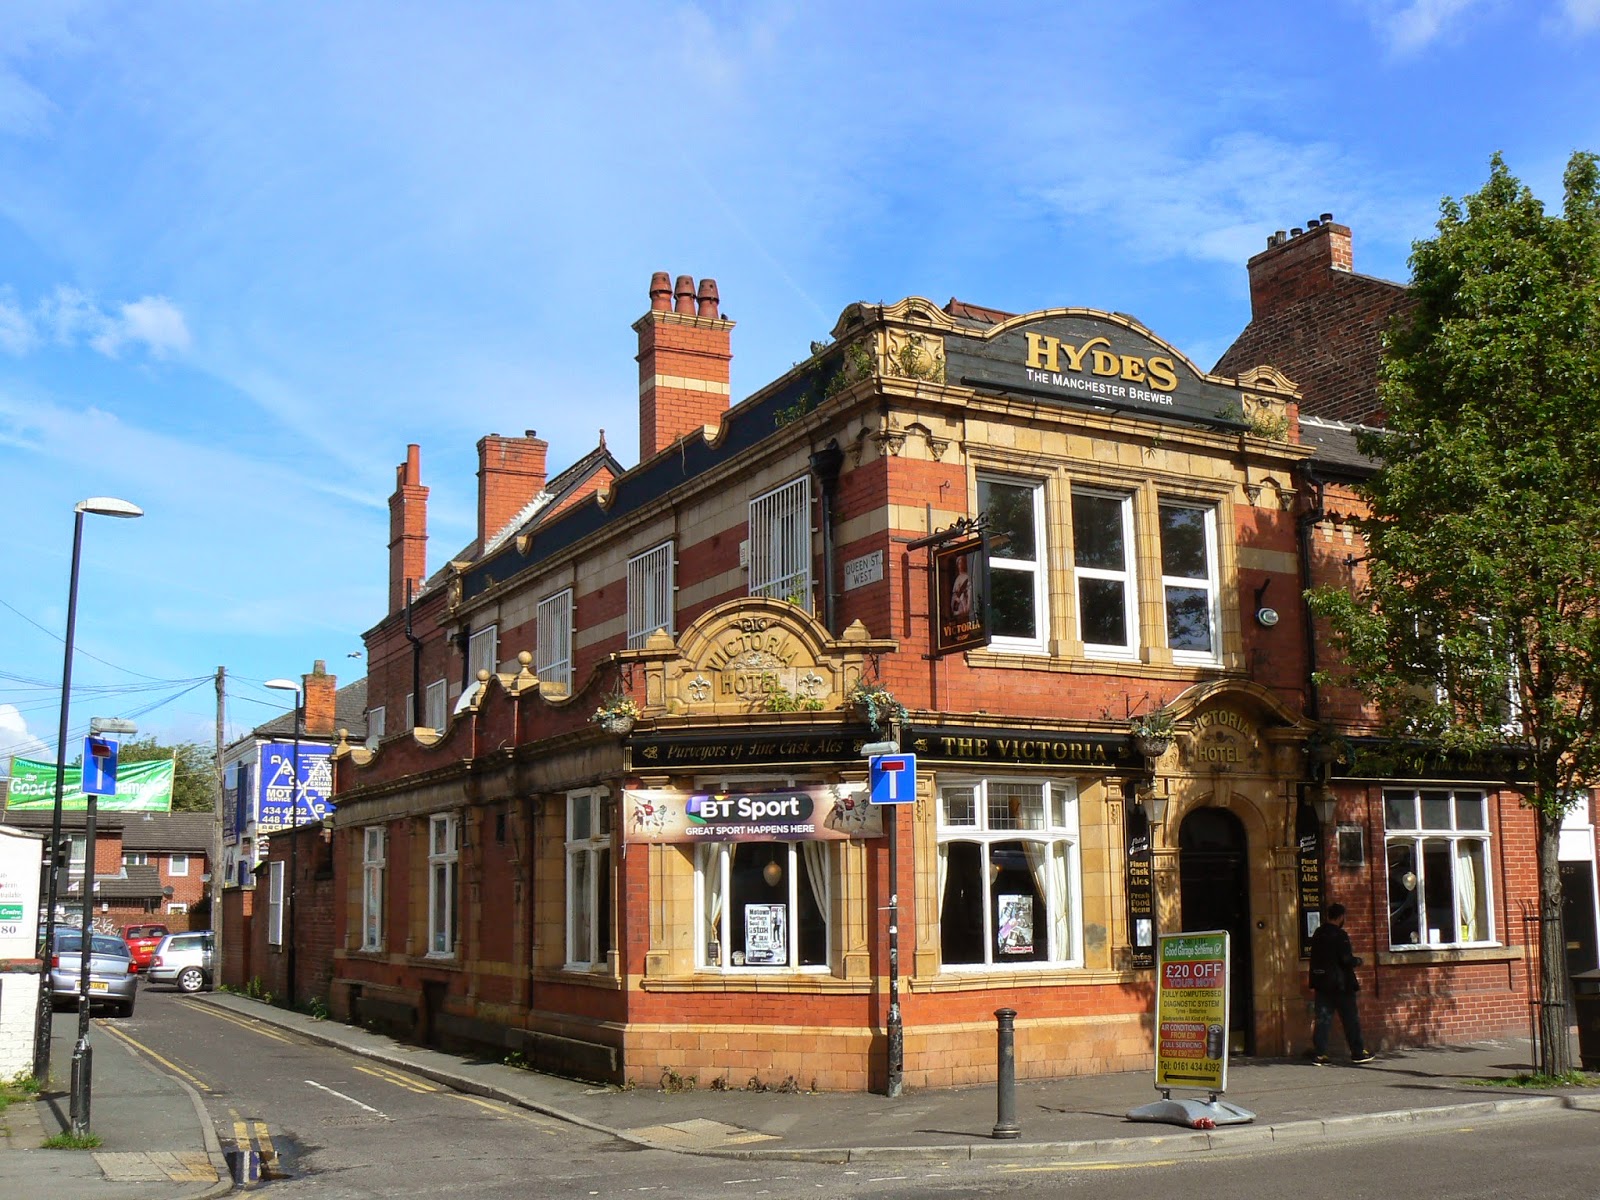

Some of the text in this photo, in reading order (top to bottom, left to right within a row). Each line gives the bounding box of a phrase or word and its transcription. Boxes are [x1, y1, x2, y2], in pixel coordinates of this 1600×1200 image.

[1024, 331, 1178, 392] HYDES
[1026, 369, 1173, 406] THE MANCHESTER BREWER
[845, 554, 881, 576] QUEEN ST.
[853, 569, 873, 585] WEST
[943, 619, 981, 637] VICTORIA
[704, 632, 800, 672] VICTORIA
[720, 672, 787, 695] HOTEL
[667, 743, 727, 761] Purveyors
[731, 743, 744, 760] of
[779, 738, 810, 755] Cask
[813, 737, 844, 754] Ales
[941, 736, 1107, 761] THE VICTORIA
[1198, 746, 1244, 762] HOTEL
[10, 779, 47, 796] Good
[266, 789, 292, 798] MOT
[262, 806, 281, 815] 434
[700, 796, 800, 820] BT Sport
[261, 816, 280, 824] 448
[685, 823, 815, 836] GREAT SPORT HAPPENS HERE
[1129, 860, 1149, 868] Finest
[1301, 865, 1318, 873] Cask
[1130, 867, 1149, 876] Cask
[1130, 878, 1150, 886] Ales
[1302, 874, 1318, 882] Ales
[1303, 893, 1319, 902] Wine
[1131, 899, 1150, 907] Food
[1131, 906, 1150, 914] Menu
[1164, 944, 1213, 957] Good Garage Scheme
[1166, 963, 1222, 978] £20 OFF
[1169, 978, 1216, 988] YOUR MOT
[1162, 990, 1222, 998] FULLY COMPUTERISED
[1163, 1000, 1220, 1008] DIAGNOSTIC SYSTEM
[1170, 1024, 1205, 1032] CONDITIONING
[1175, 1041, 1203, 1049] SERVICING
[1162, 1049, 1178, 1057] FROM
[1160, 1060, 1221, 1073] Tel: 0161 434 4392
